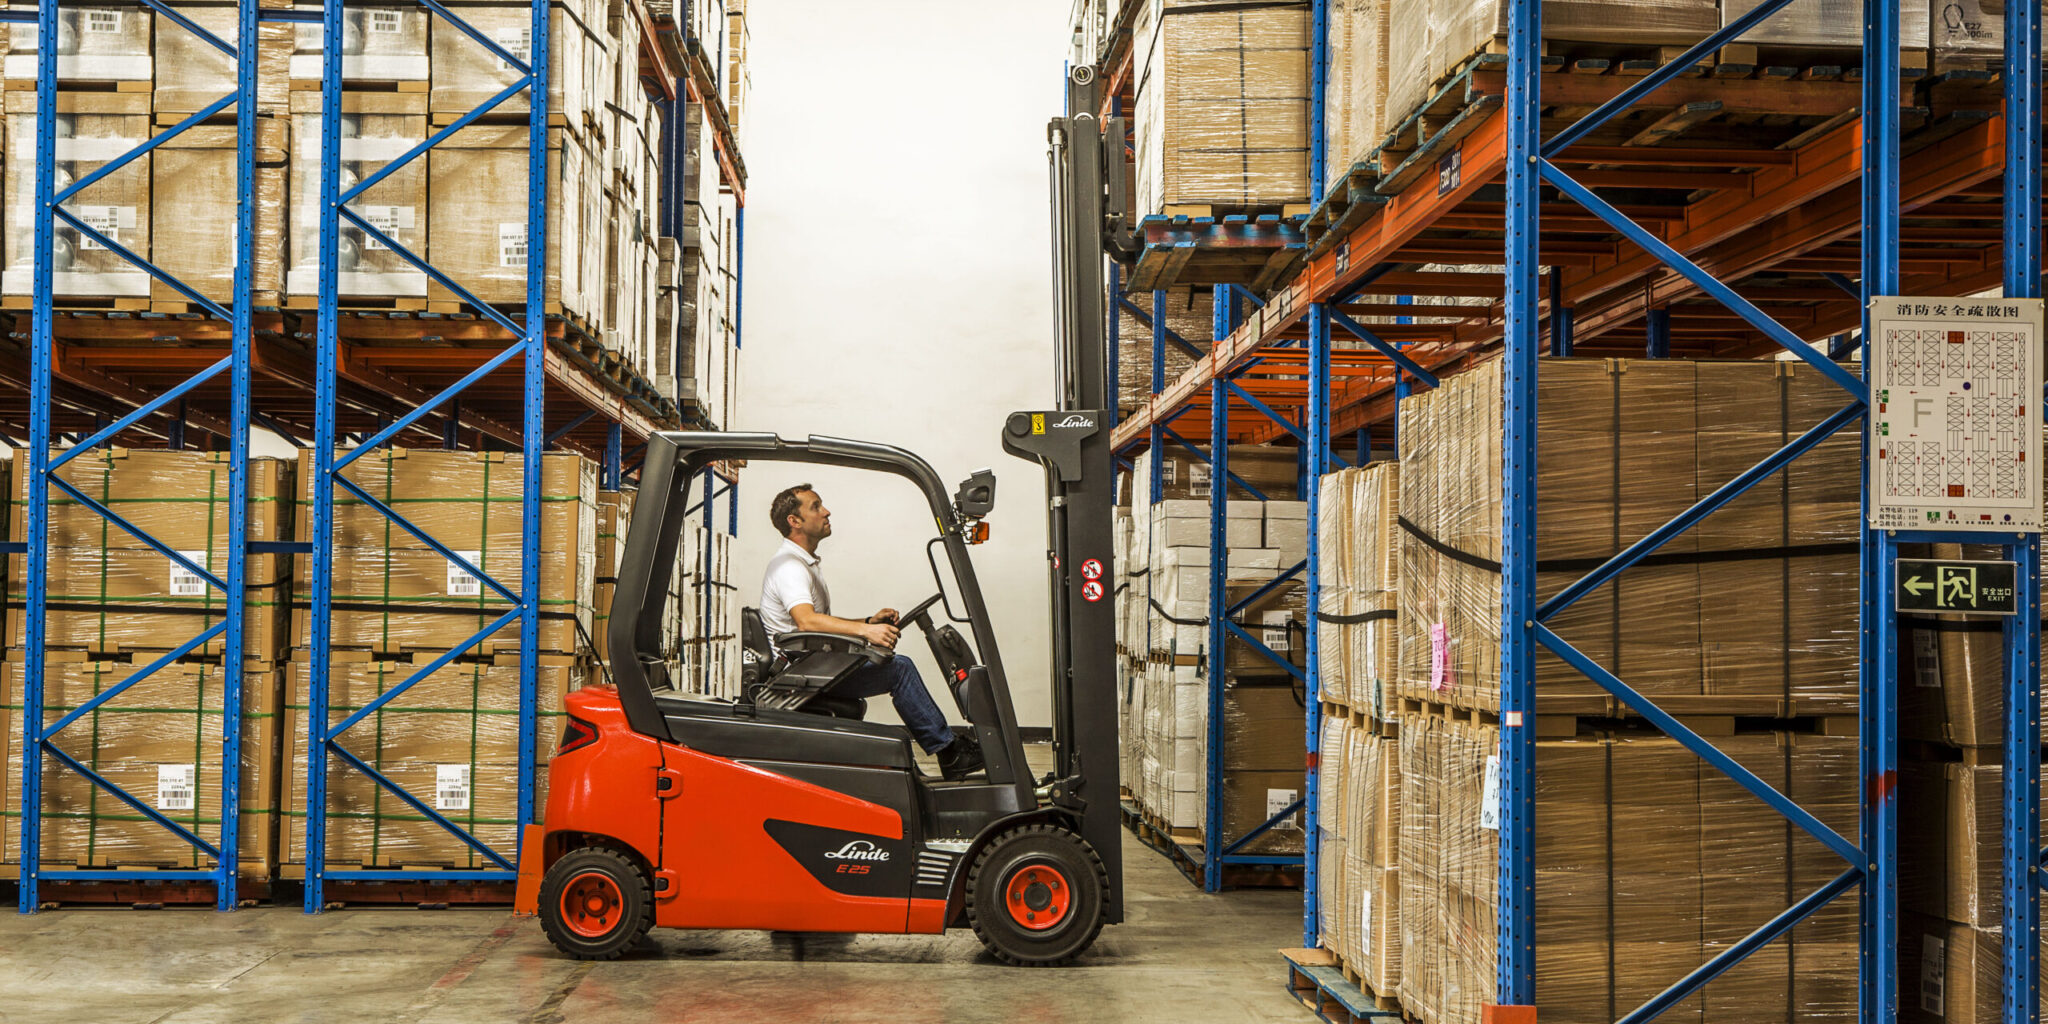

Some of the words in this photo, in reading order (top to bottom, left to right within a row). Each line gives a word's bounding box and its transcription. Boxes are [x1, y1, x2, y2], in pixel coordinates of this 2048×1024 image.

[1896, 304, 2019, 318] 消防安全疏散图
[1914, 399, 1934, 428] F
[1052, 415, 1094, 428] Linde
[1982, 587, 2012, 596] 安全出口
[824, 840, 890, 861] Linde
[836, 864, 849, 873] E
[848, 864, 871, 874] 25
